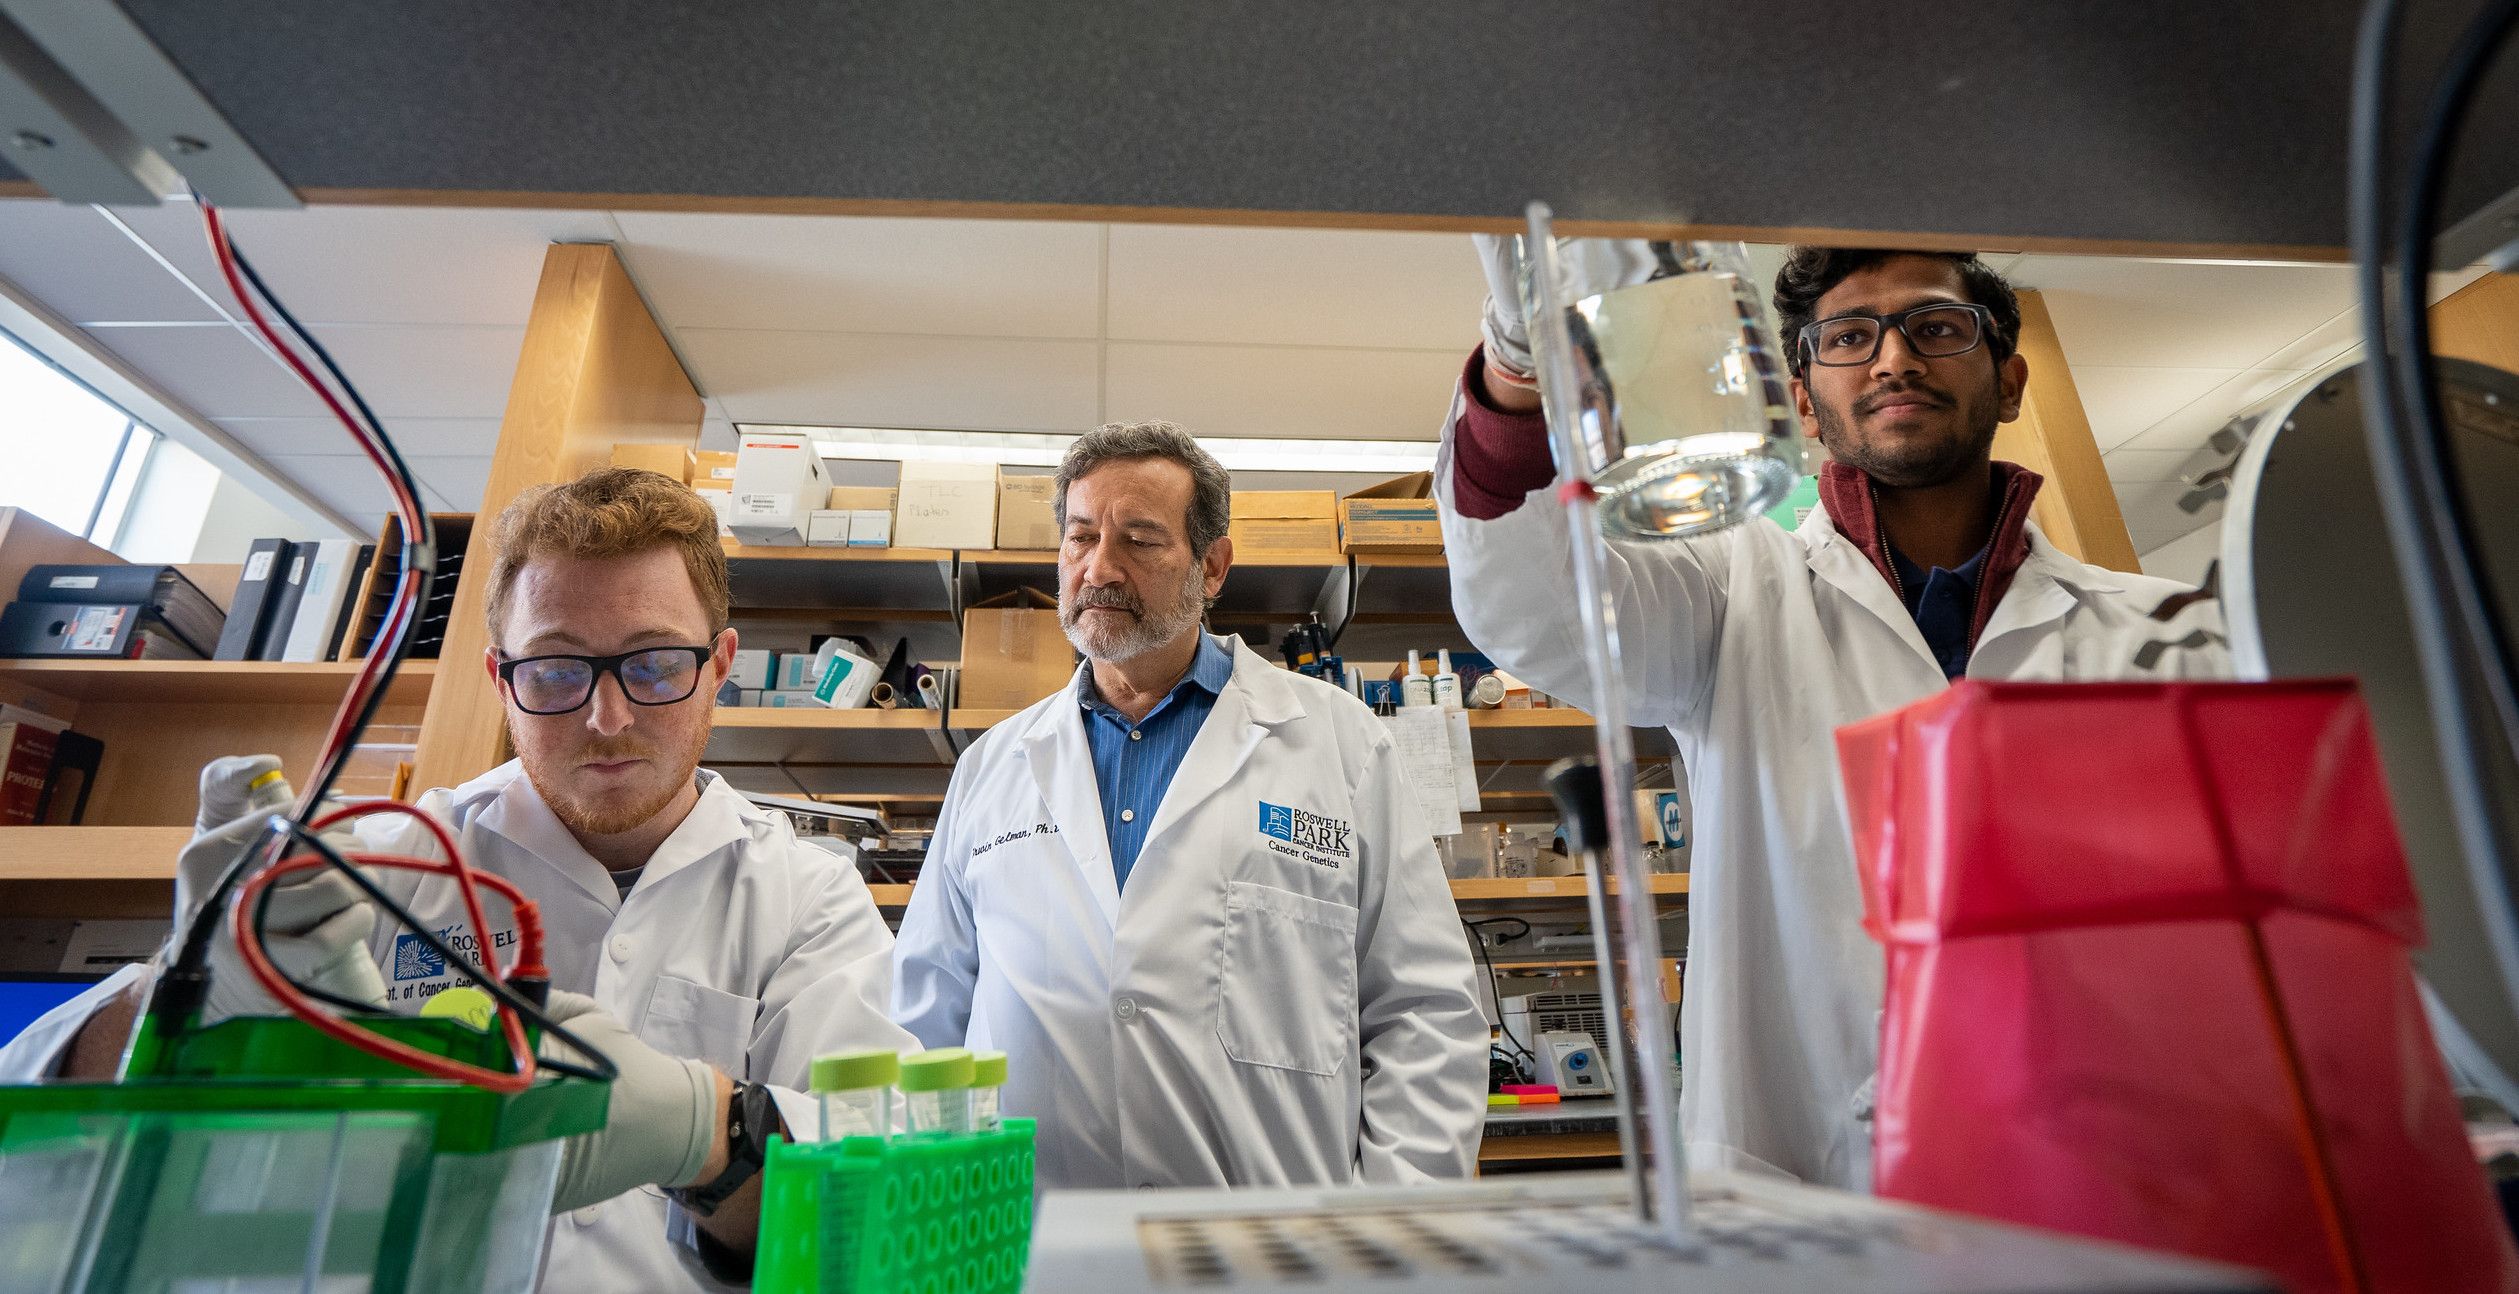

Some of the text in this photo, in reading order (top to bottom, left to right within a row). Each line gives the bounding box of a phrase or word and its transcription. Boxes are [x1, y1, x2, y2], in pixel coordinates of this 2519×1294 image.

[1294, 808, 1351, 832] ROSWELL
[1293, 819, 1350, 852] PARK
[1268, 840, 1340, 869] Cancer Genetics
[1292, 838, 1350, 859] CANCER INSTITUTE
[403, 984, 414, 999] of
